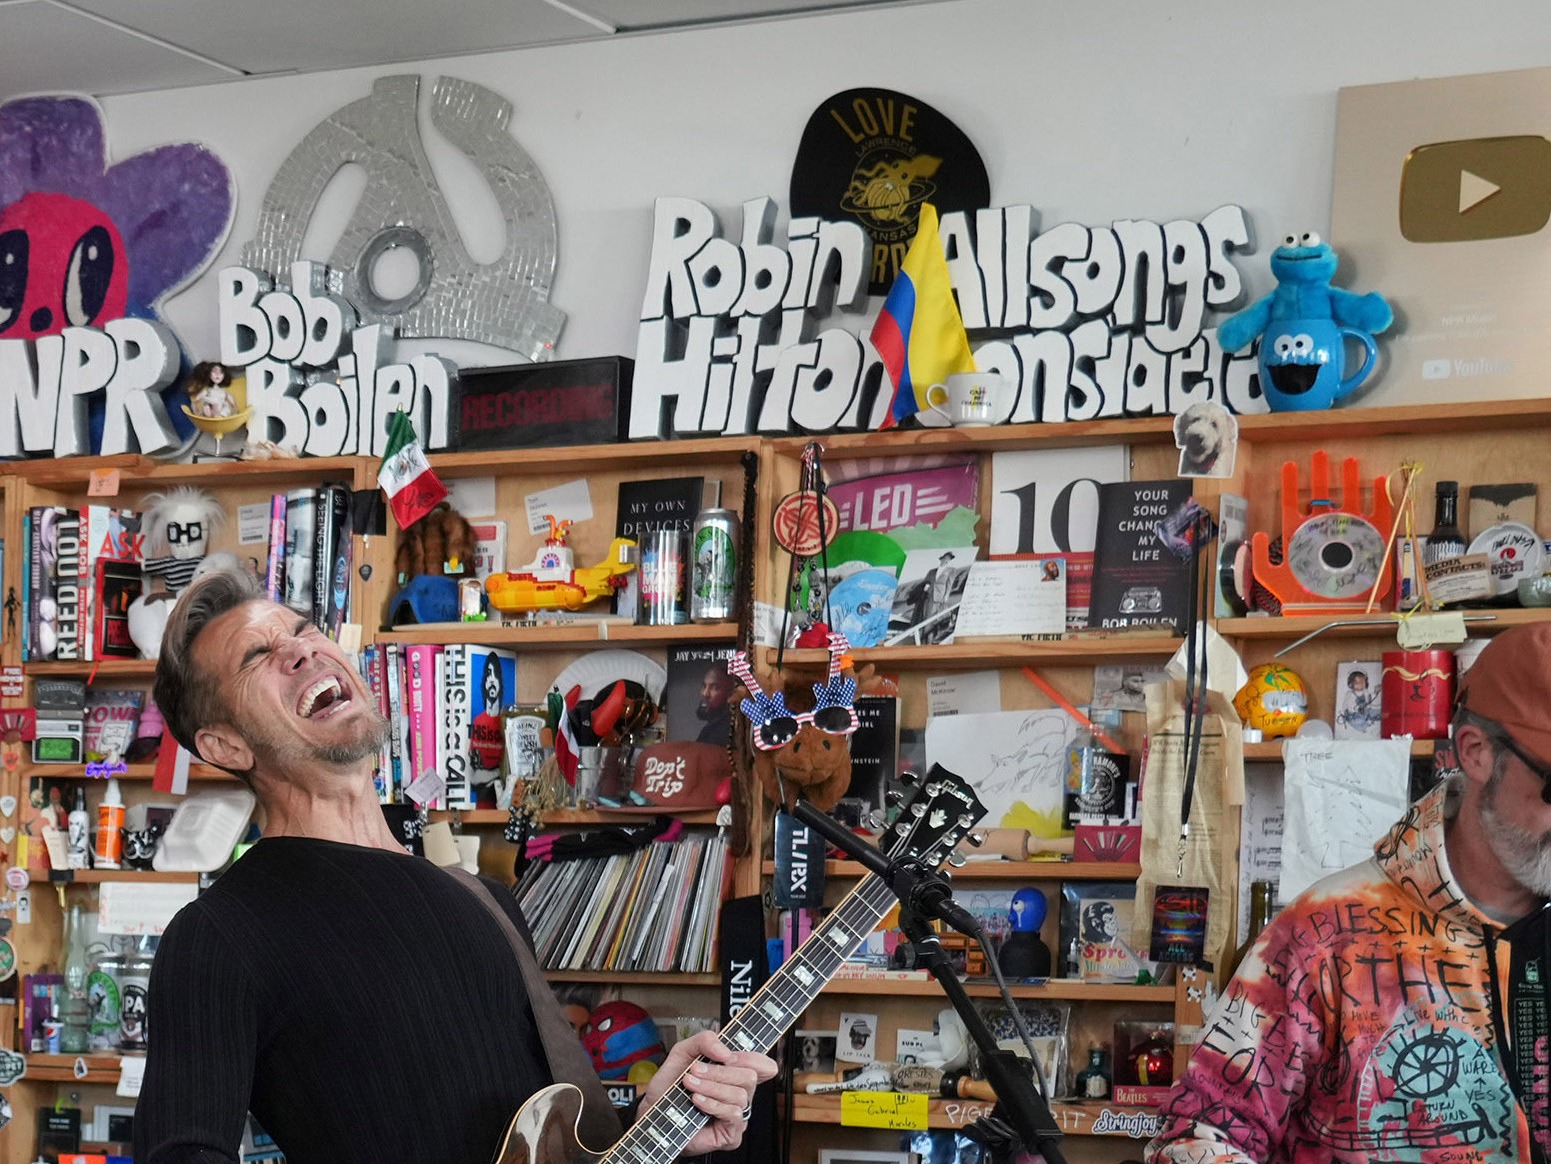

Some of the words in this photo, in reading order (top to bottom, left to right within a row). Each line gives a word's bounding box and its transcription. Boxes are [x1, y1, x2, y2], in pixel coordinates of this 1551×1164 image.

[831, 98, 918, 143] LOVE
[869, 224, 916, 241] ANSAS
[641, 196, 868, 318] Robin
[938, 203, 1249, 355] Allsongs
[219, 260, 353, 368] Bob
[630, 308, 893, 440] Hilton
[246, 324, 453, 457] Boilen
[462, 382, 615, 430] RECORDING
[630, 502, 648, 514] MY
[655, 500, 685, 512] OWN
[1135, 490, 1169, 501] YOUR
[1000, 478, 1101, 554] 10
[1133, 505, 1167, 516] SONG
[623, 519, 690, 536] DEVICES
[1138, 536, 1155, 546] MY
[100, 531, 147, 559] ASK
[1132, 550, 1160, 561] LIFE
[79, 548, 87, 575] BOB
[57, 585, 79, 660] REED
[1102, 618, 1128, 629] BOB
[446, 644, 466, 704] THIS
[645, 756, 685, 776] Don't
[1300, 750, 1334, 763] TREE
[446, 754, 466, 803] CALL
[646, 777, 684, 798] Trip
[941, 779, 974, 808] Gibson
[1117, 1089, 1148, 1104] BEATLES
[1093, 1110, 1160, 1138] Stringjoy
